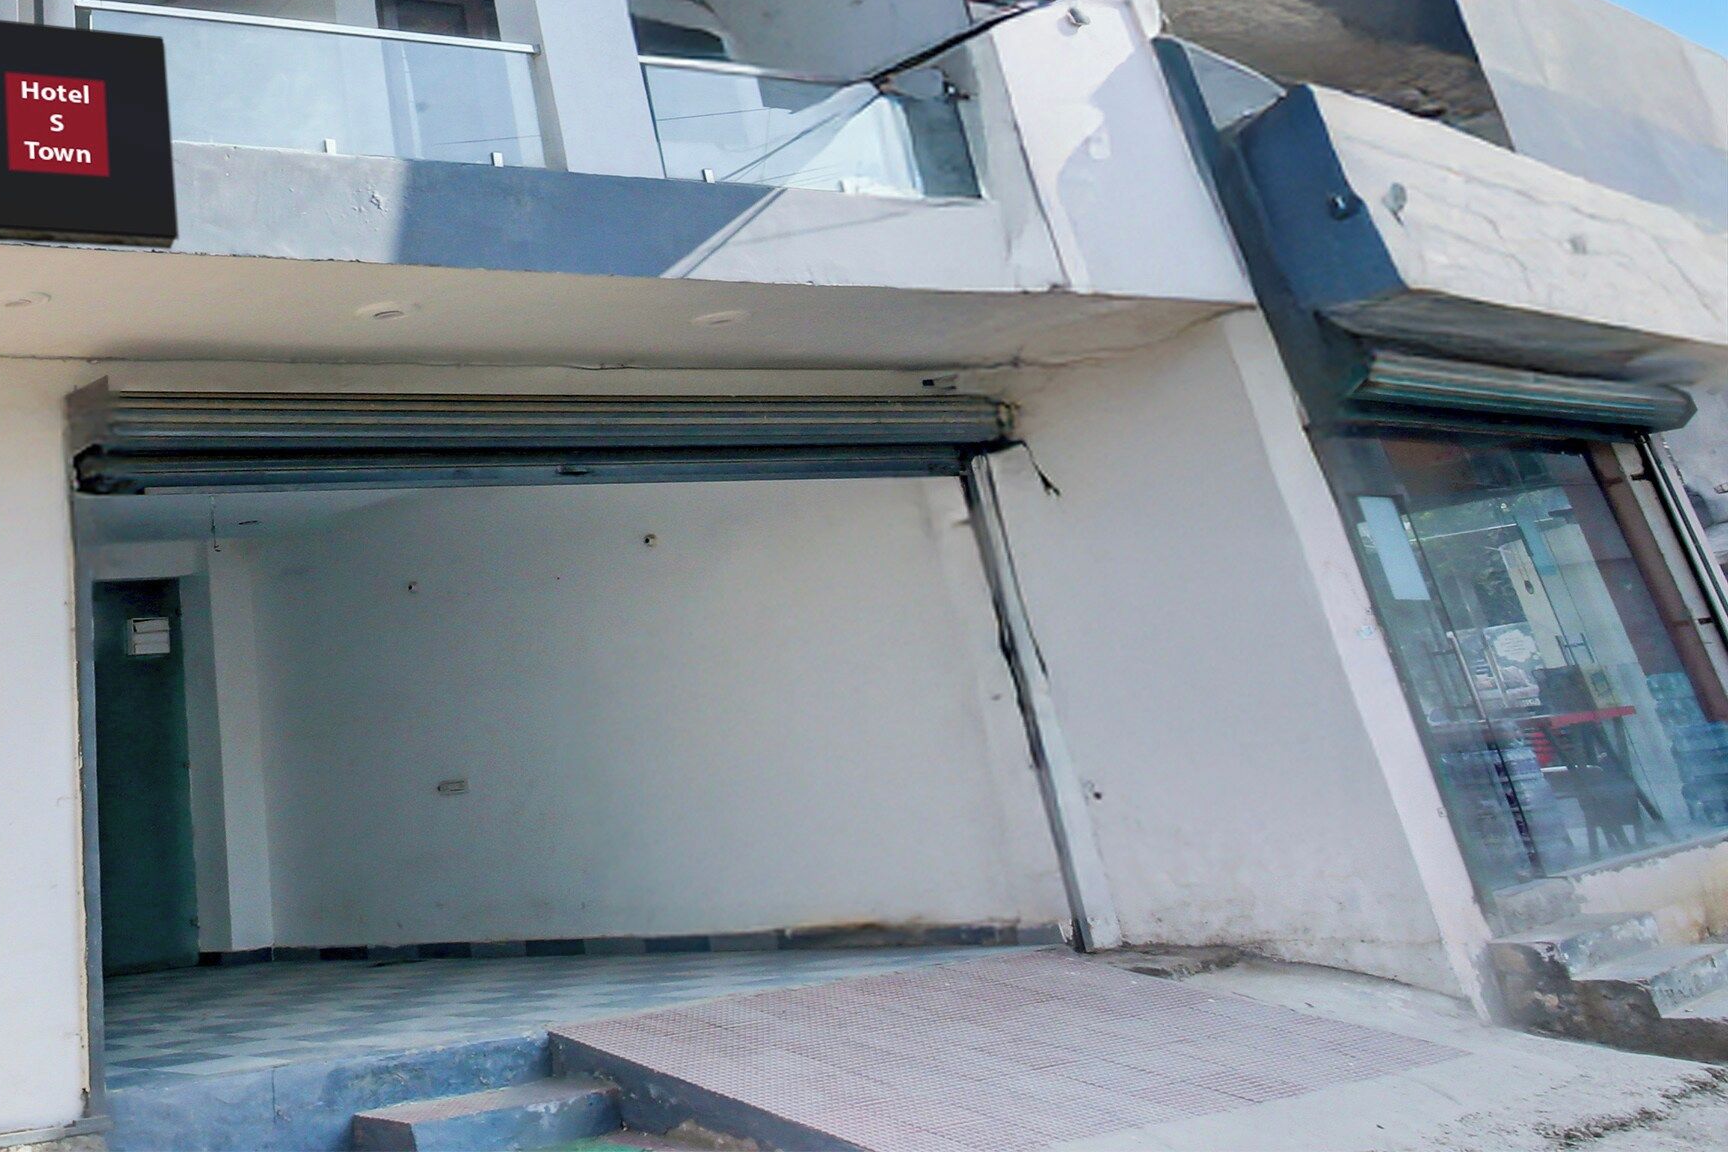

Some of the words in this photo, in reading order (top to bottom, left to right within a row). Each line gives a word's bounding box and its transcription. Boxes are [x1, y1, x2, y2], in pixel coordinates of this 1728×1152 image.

[21, 81, 90, 105] Hotel
[50, 114, 64, 132] S
[24, 140, 92, 164] Town
